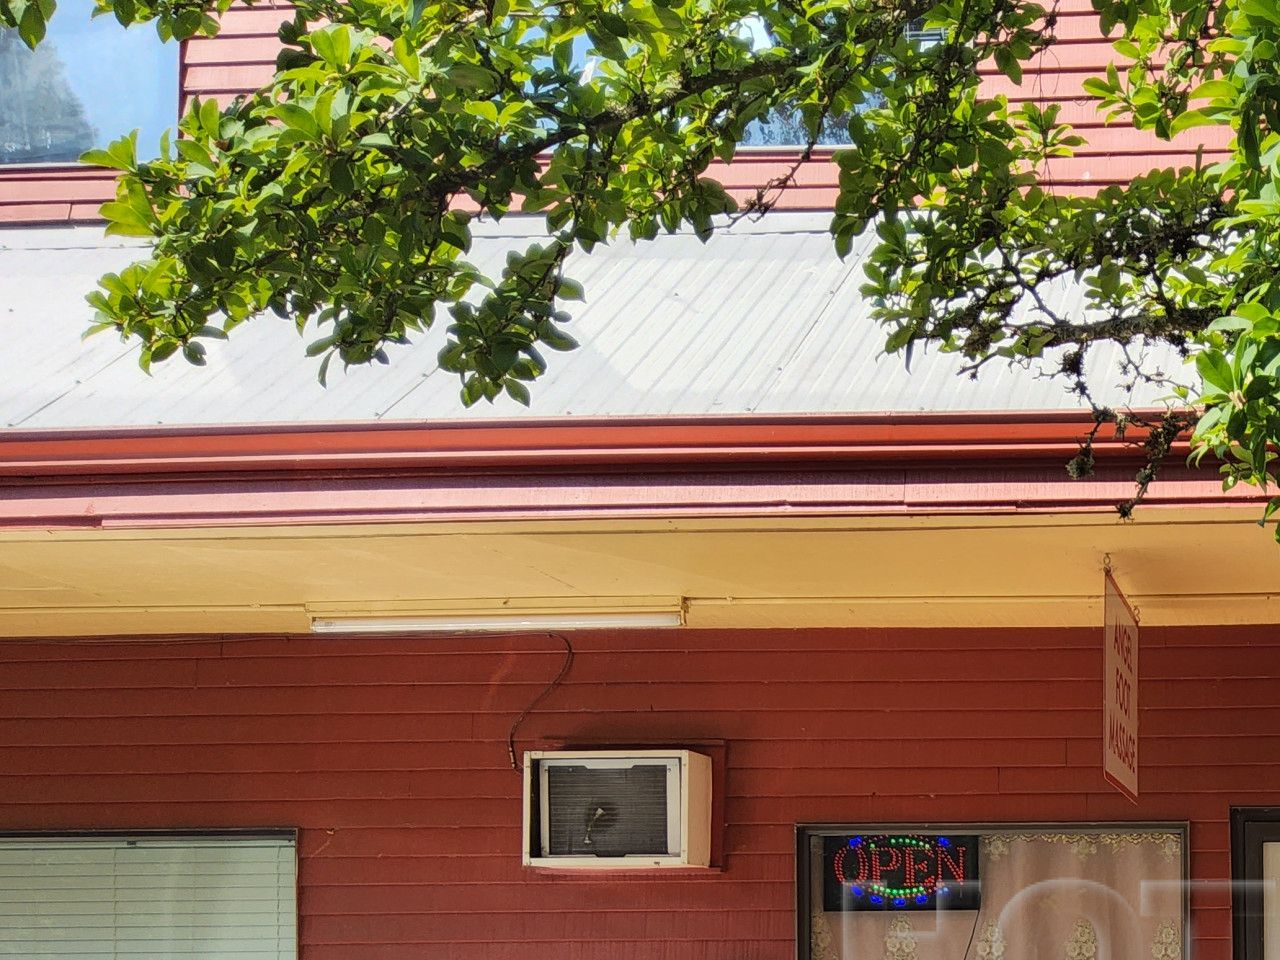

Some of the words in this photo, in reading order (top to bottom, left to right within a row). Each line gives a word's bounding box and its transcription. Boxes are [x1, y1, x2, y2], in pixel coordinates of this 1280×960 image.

[1115, 666, 1131, 720] FOOT
[1109, 712, 1136, 774] MASSAGE
[833, 845, 967, 887] OPEN
